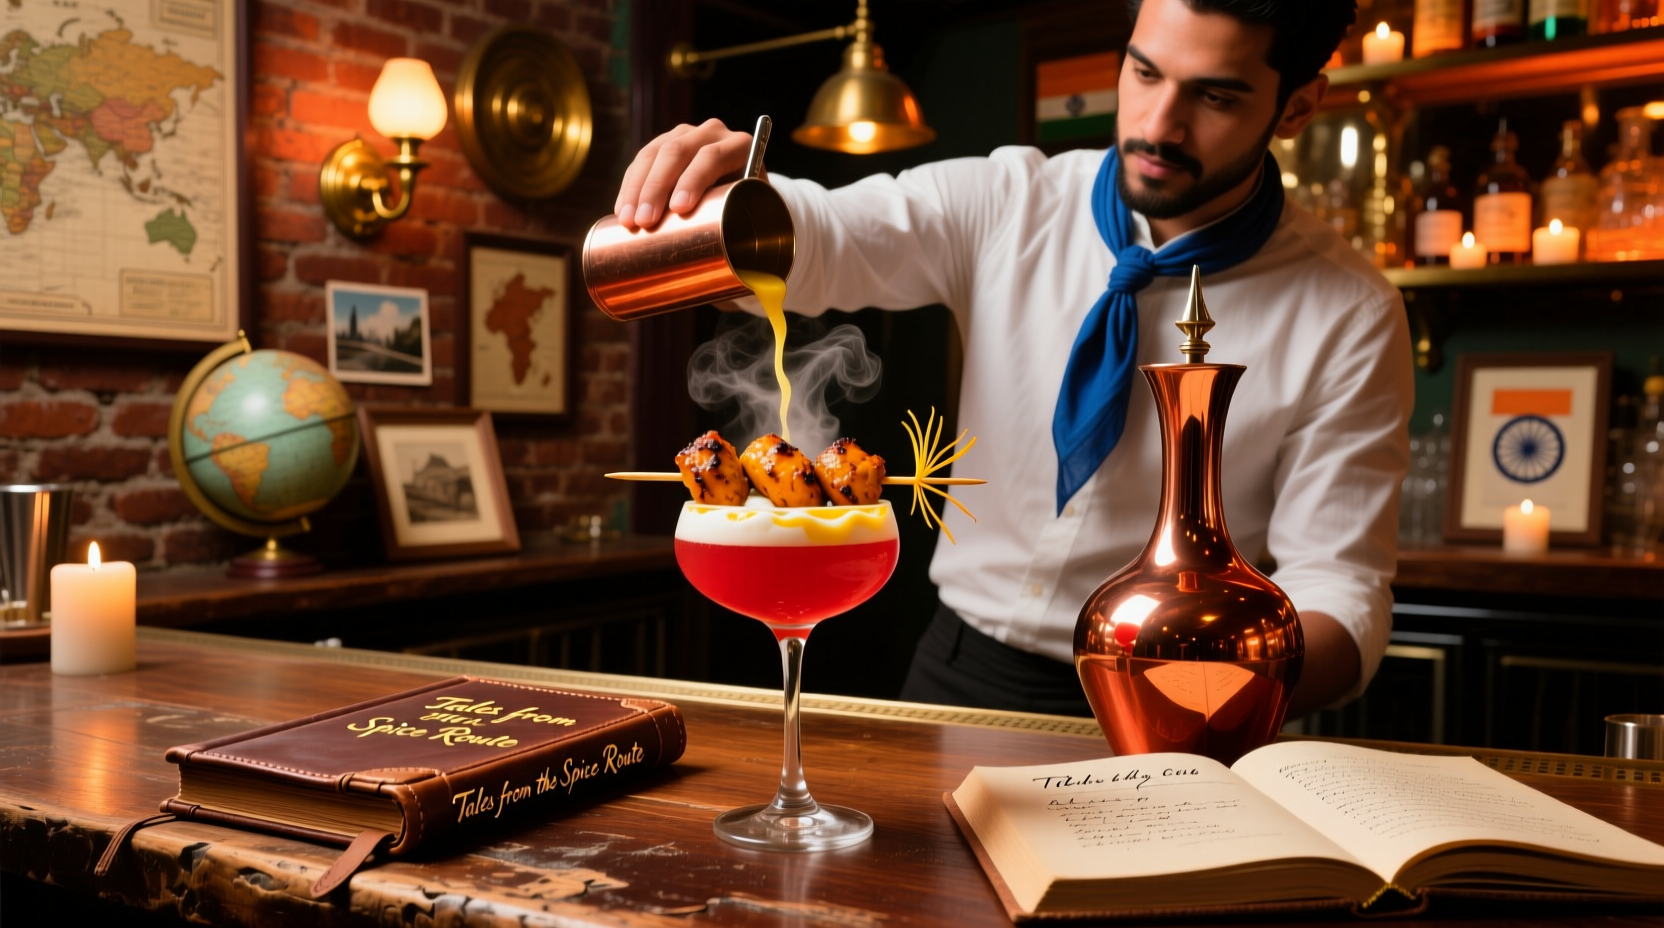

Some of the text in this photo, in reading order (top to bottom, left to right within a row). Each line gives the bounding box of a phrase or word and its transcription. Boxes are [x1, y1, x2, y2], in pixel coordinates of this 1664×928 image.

[425, 697, 504, 715] Tales
[491, 707, 577, 727] from
[347, 717, 428, 738] Spice
[452, 786, 494, 823] Tales
[494, 780, 531, 818] from
[559, 757, 600, 795] Spice
[602, 741, 645, 774] Route
